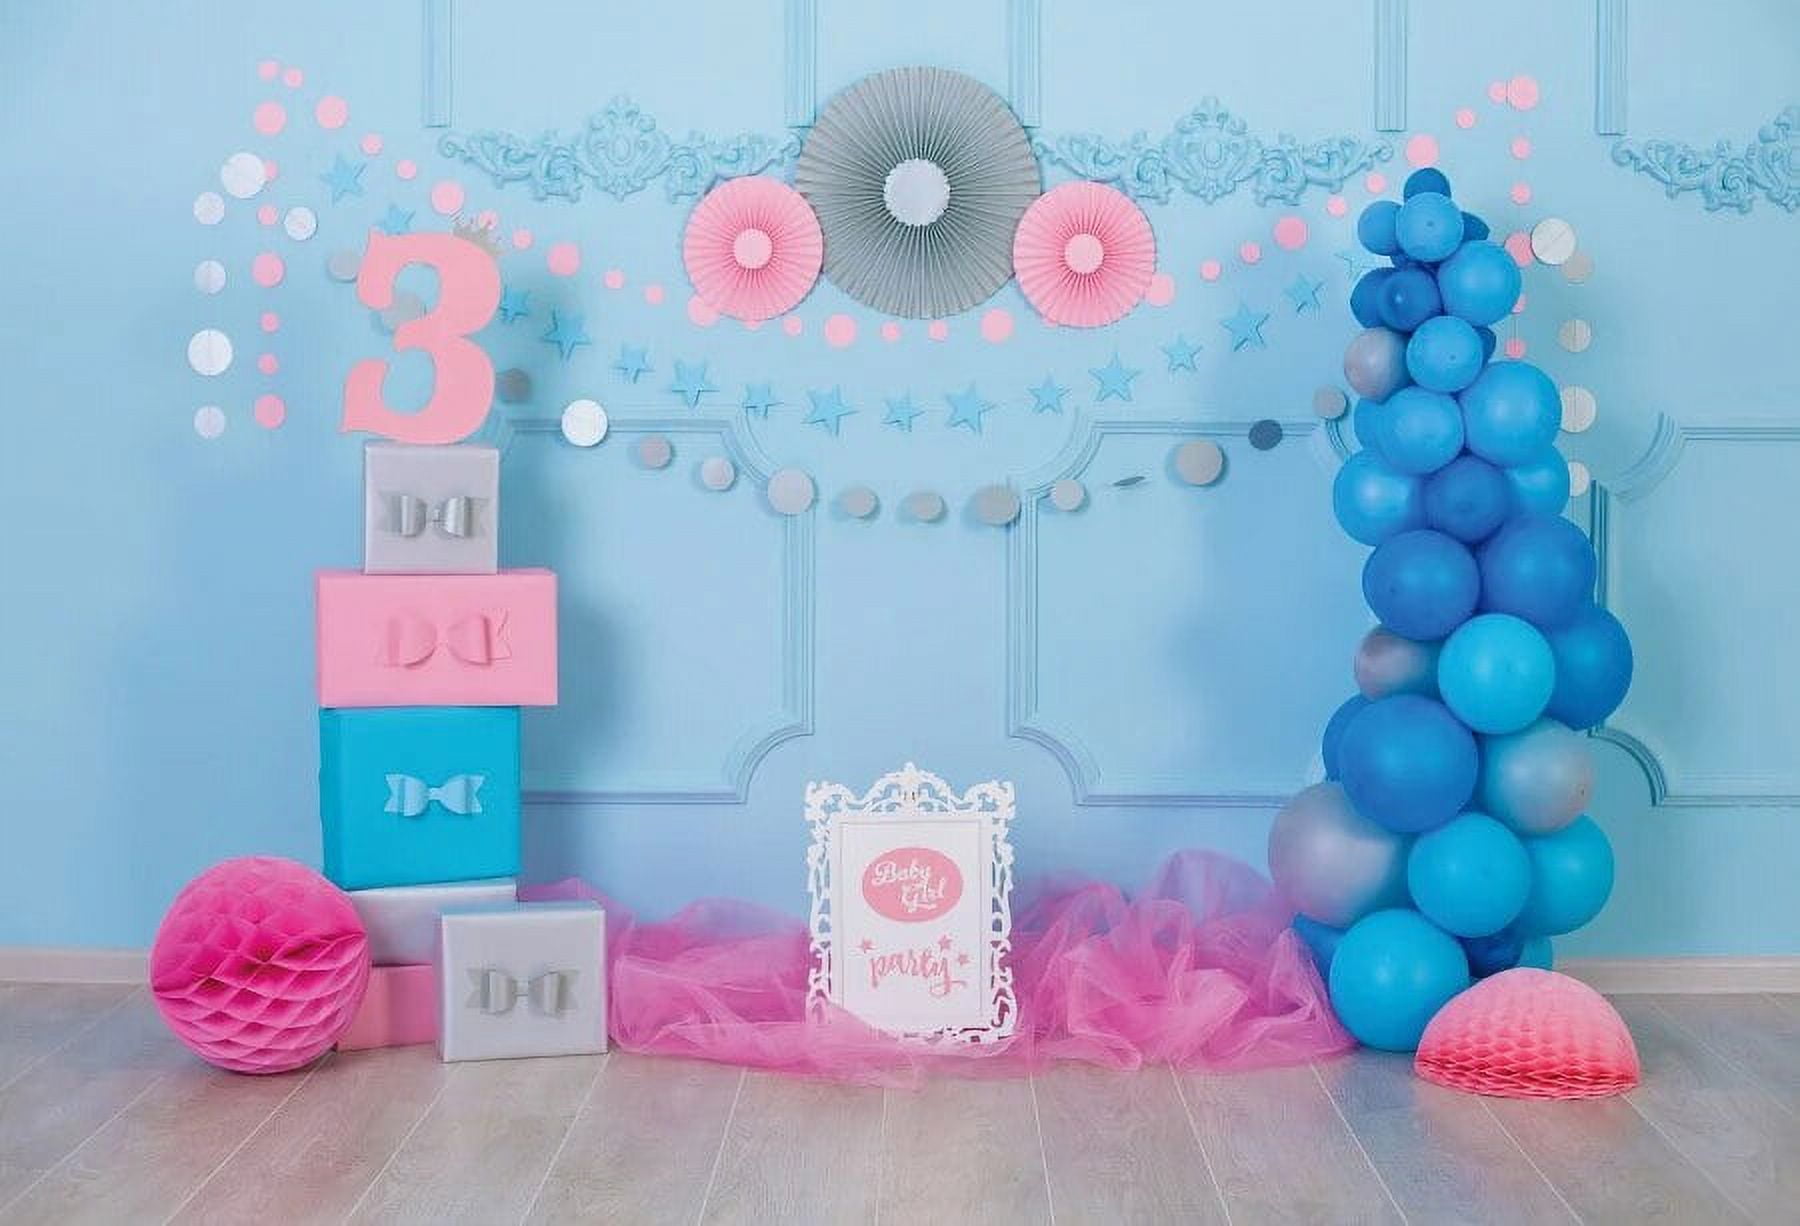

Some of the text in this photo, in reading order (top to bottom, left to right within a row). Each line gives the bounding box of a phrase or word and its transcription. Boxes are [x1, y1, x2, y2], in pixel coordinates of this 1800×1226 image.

[341, 228, 501, 444] 3
[872, 860, 930, 886] Baby
[900, 878, 945, 912] Girl
[870, 949, 966, 996] party
